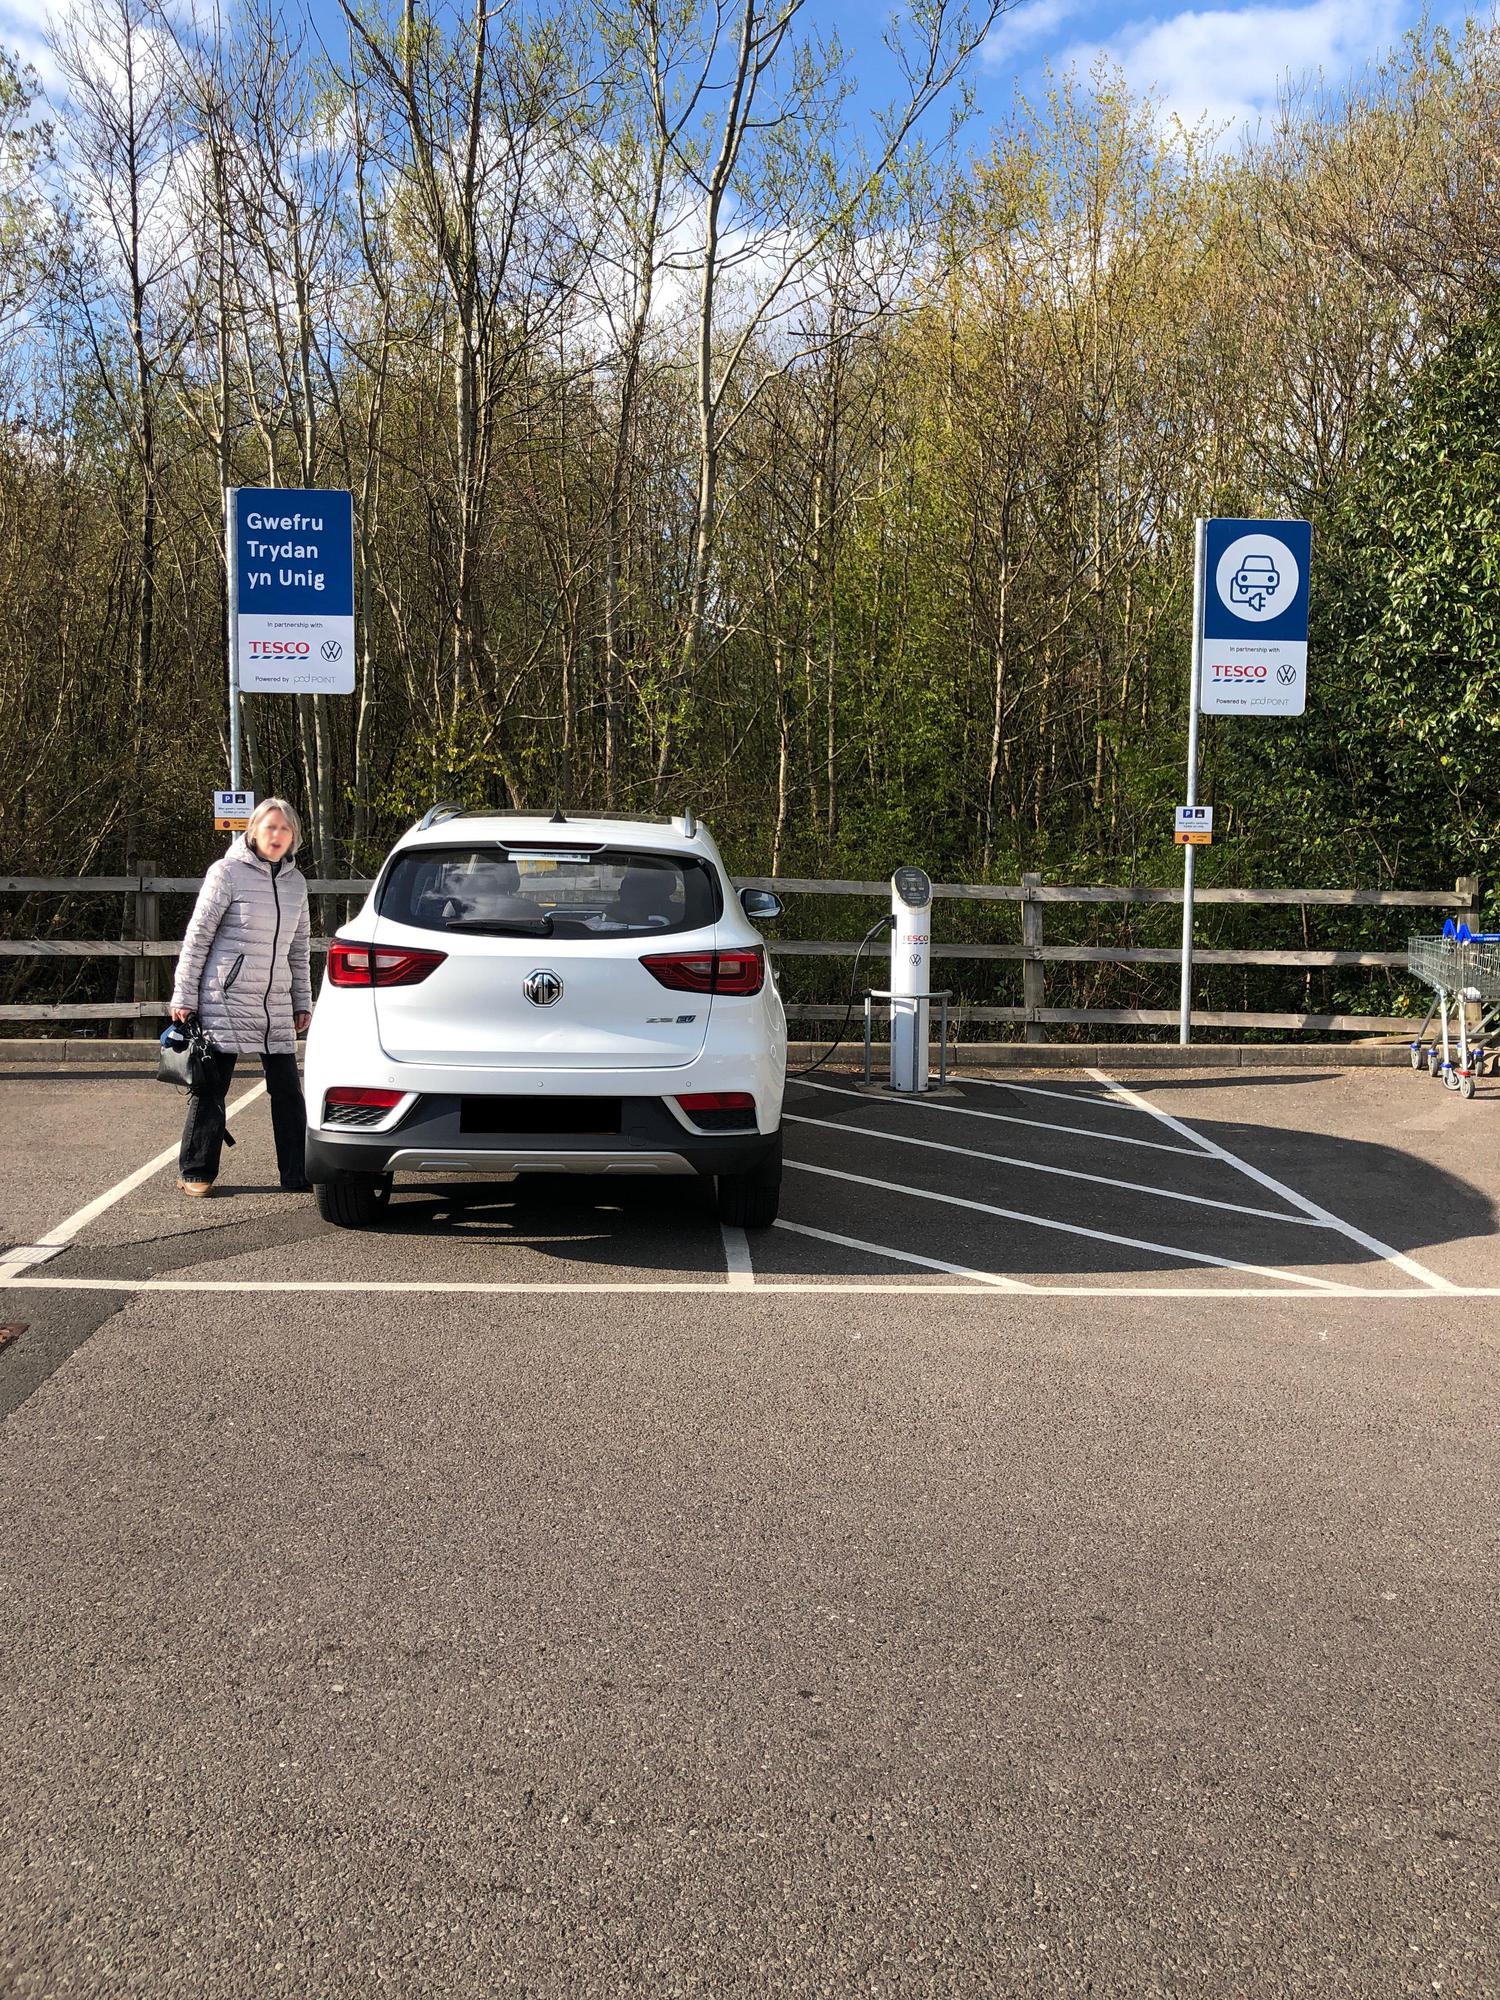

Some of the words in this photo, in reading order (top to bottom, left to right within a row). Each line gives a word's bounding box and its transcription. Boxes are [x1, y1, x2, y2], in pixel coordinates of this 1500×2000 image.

[246, 512, 324, 531] Gwefru
[246, 540, 319, 562] Trydan
[247, 571, 272, 590] yn
[279, 569, 326, 591] Unig
[248, 641, 310, 654] TESCO
[320, 640, 343, 662] VW
[255, 675, 281, 683] Powered
[282, 676, 289, 684] by
[1211, 665, 1267, 678] TESCO
[1276, 664, 1297, 686] VW
[526, 971, 561, 1005] MG
